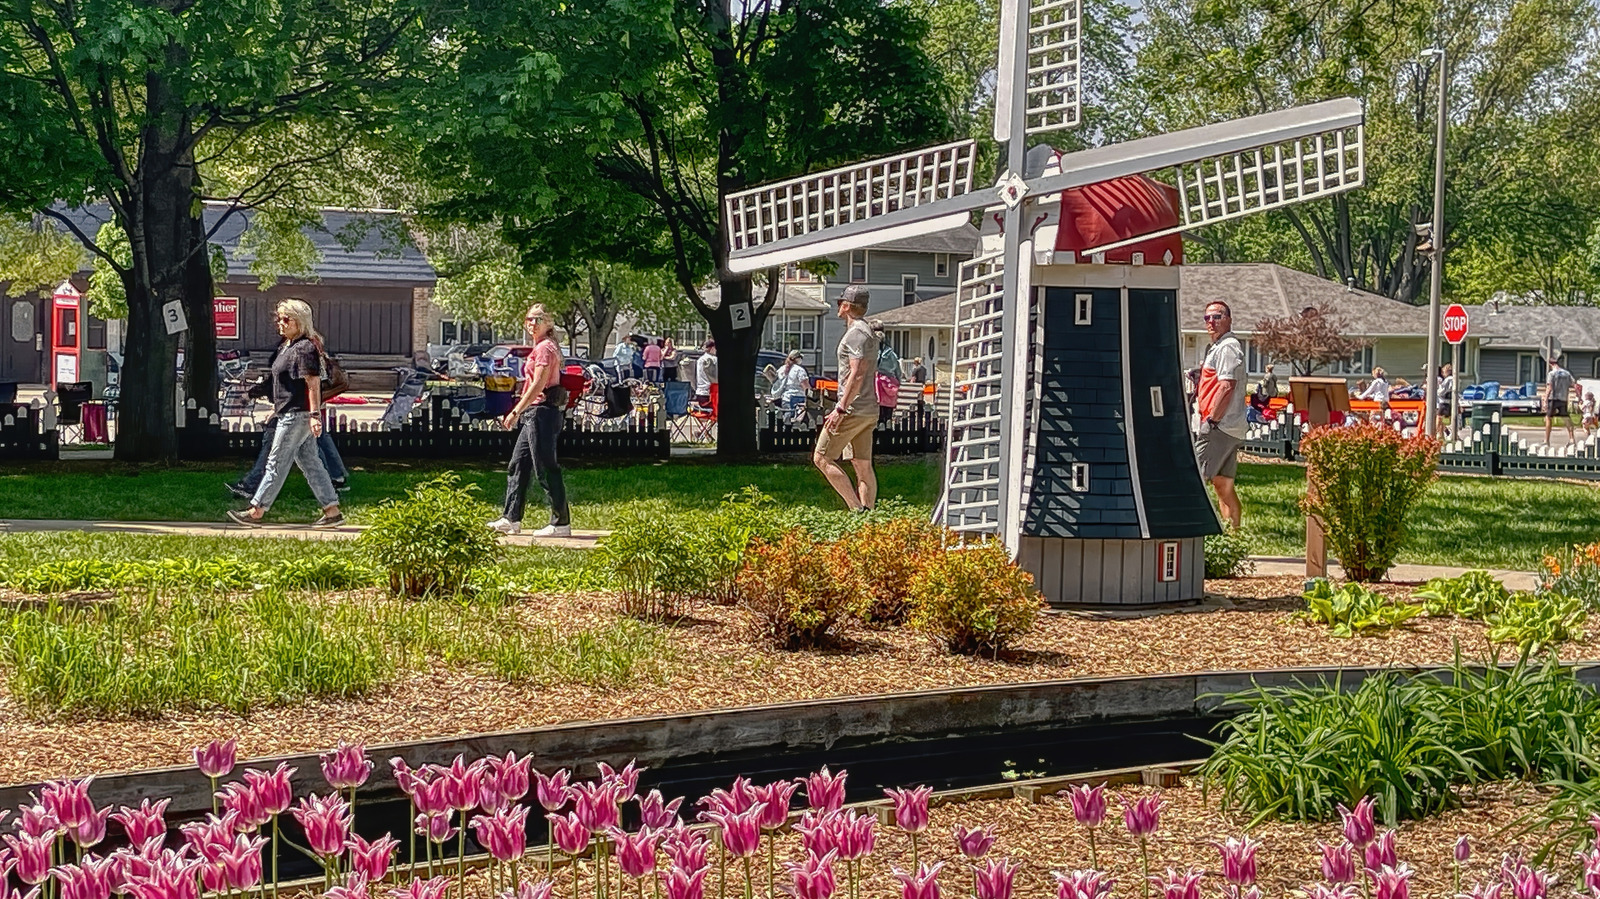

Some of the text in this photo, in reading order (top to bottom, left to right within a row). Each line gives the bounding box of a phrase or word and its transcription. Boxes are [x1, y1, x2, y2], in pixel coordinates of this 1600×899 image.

[167, 308, 179, 323] 3
[735, 308, 746, 321] 2
[1444, 316, 1466, 331] STOP
